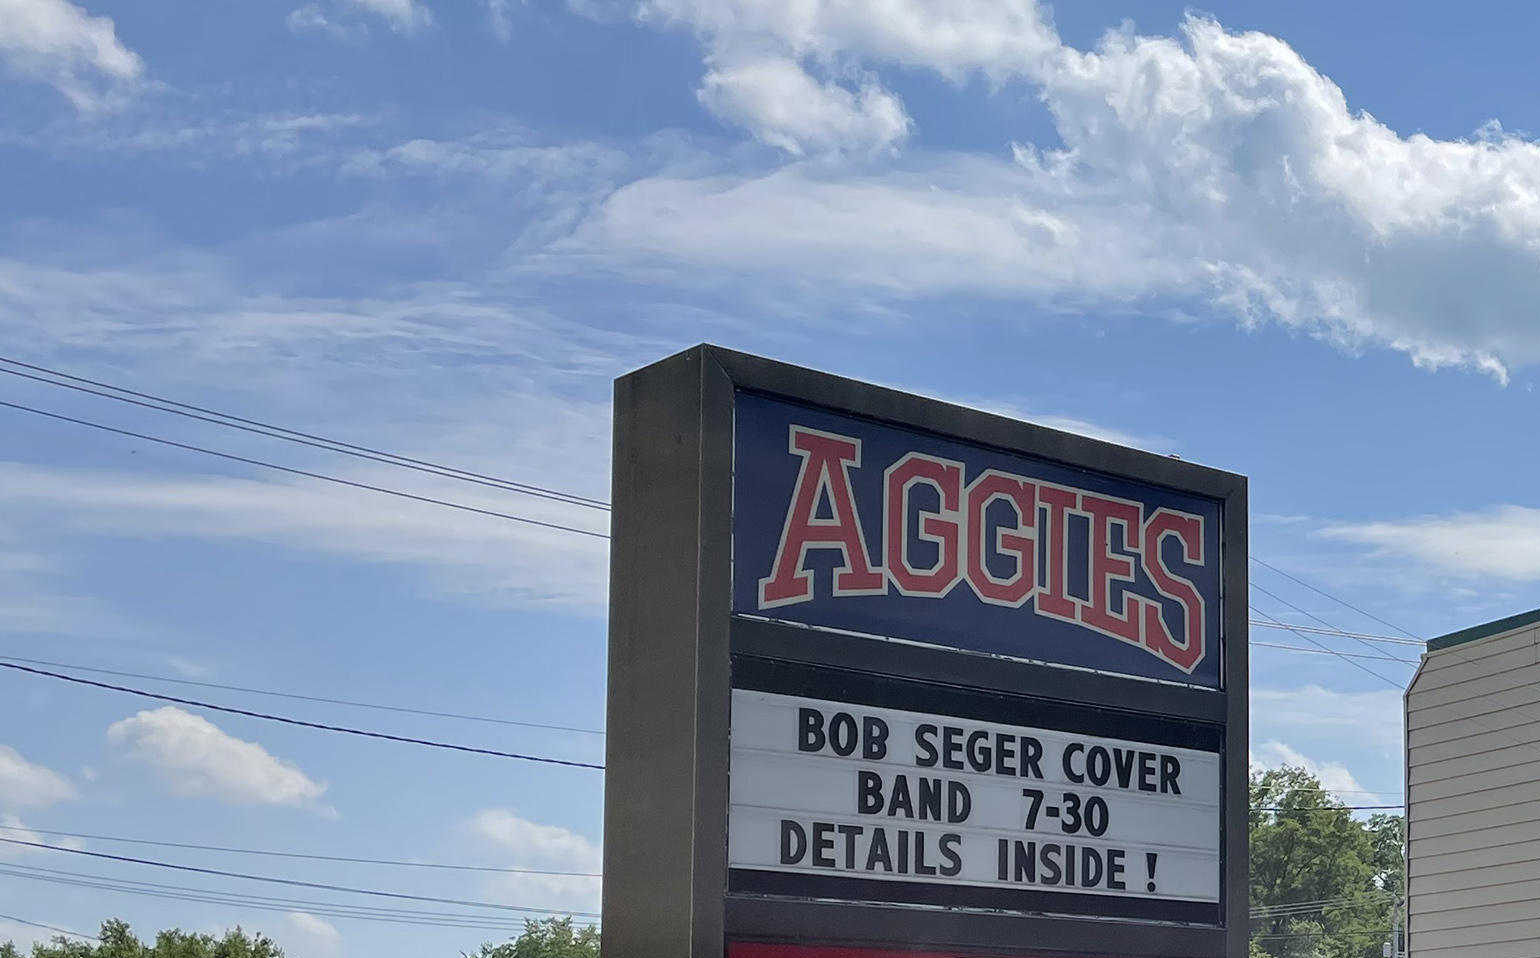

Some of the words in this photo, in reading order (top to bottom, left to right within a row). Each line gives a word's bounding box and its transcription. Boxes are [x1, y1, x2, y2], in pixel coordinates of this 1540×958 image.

[758, 424, 1206, 675] AGGIES
[798, 707, 888, 761] BOB
[914, 724, 1044, 779] SEGER
[1062, 742, 1182, 796] COVER
[857, 771, 972, 824] BAND
[1022, 789, 1110, 838] 7-30
[780, 820, 963, 877] DETAILS
[997, 839, 1127, 891] INSIDE
[1146, 853, 1158, 892] !
